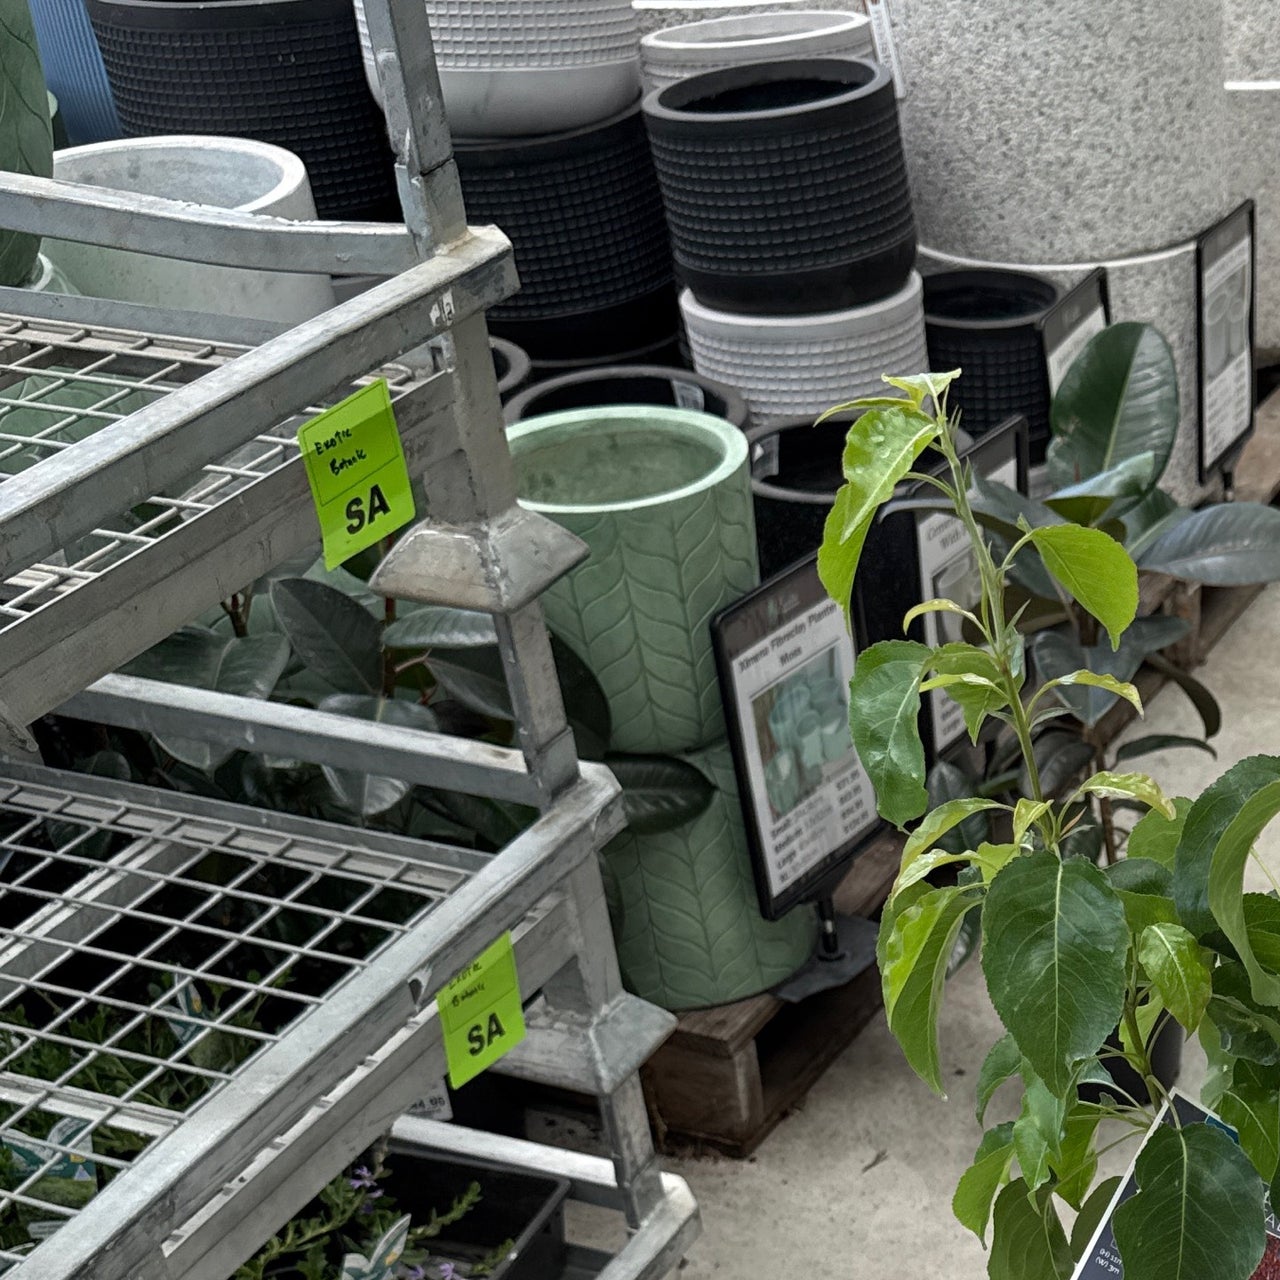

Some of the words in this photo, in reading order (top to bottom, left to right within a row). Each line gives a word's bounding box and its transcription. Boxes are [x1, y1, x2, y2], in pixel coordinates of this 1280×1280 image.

[345, 484, 391, 535] SA
[467, 1012, 506, 1057] SA
[1108, 1264, 1120, 1275] 3m
